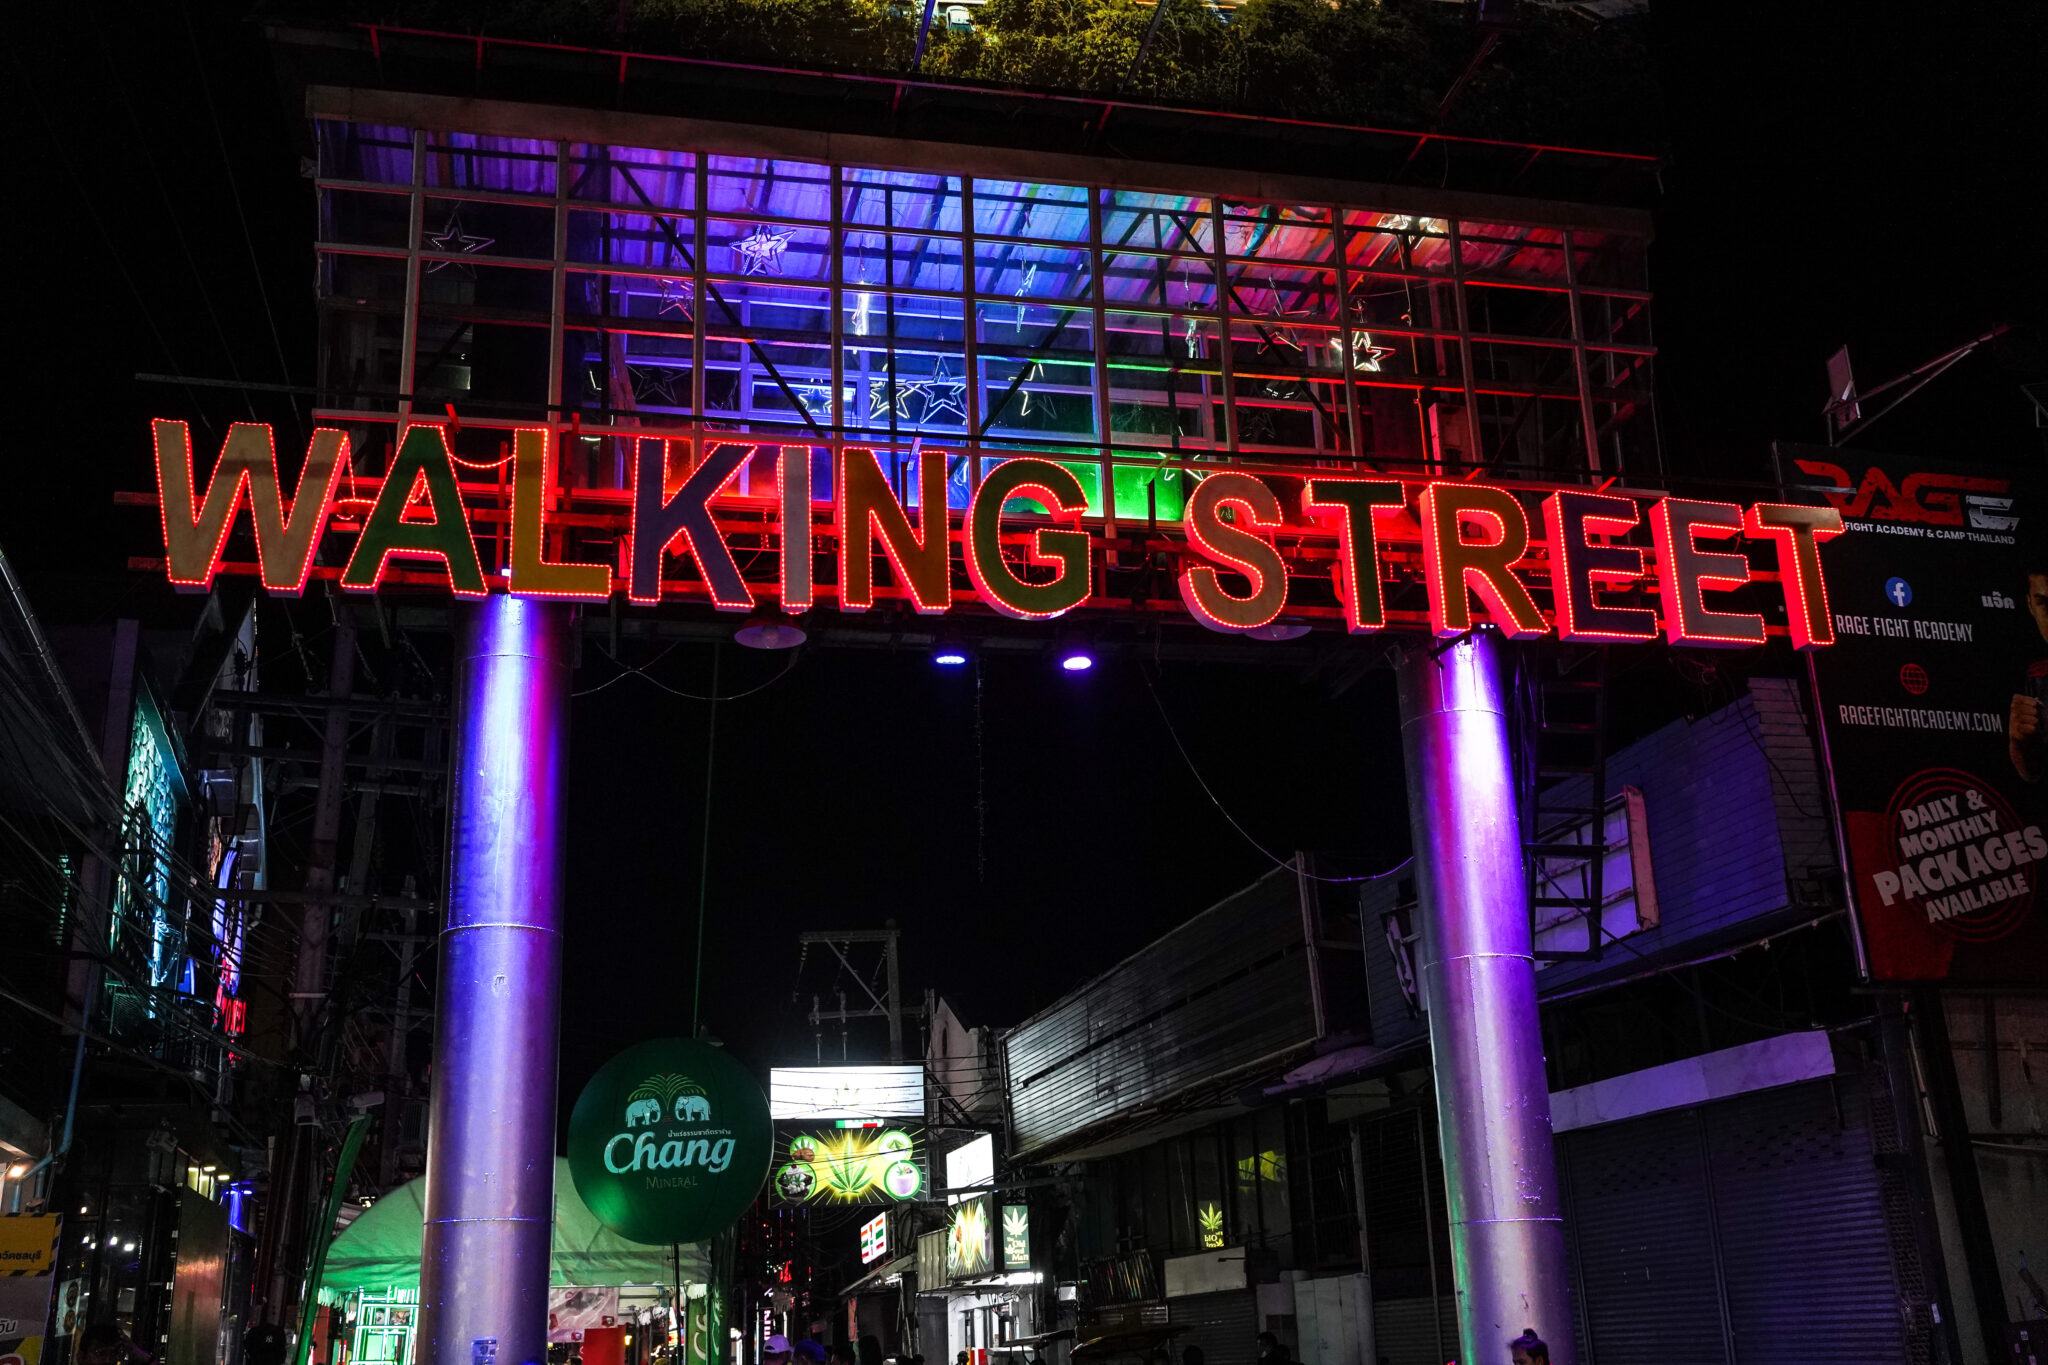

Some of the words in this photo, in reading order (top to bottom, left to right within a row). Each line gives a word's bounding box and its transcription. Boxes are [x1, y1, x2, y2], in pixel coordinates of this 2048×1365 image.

[1793, 459, 2021, 532] RAGE
[151, 416, 1093, 620] WALKING
[1178, 470, 1846, 650] STREET
[1845, 521, 1874, 533] FIGHT
[1876, 523, 1925, 538] ACADEMY
[1926, 529, 1935, 539] &
[1936, 530, 1966, 541] CAMP
[1967, 532, 2016, 545] THAILAND
[1836, 615, 1871, 636] RAGE
[1873, 617, 1911, 639] FIGHT
[1914, 620, 1974, 643] ACADEMY
[1839, 704, 2003, 733] RAGEFIGHTACADEMY.COM
[1900, 794, 1959, 831] DAILY
[1965, 788, 1987, 810] &
[1899, 809, 2001, 860] MONTHLY
[1872, 826, 2048, 907] PACKAGES
[1926, 872, 2031, 924] AVAILABLE
[603, 1131, 737, 1175] Chang
[646, 1175, 699, 1190] MINERAL
[1011, 1239, 1026, 1248] Old
[1011, 1253, 1029, 1262] Man
